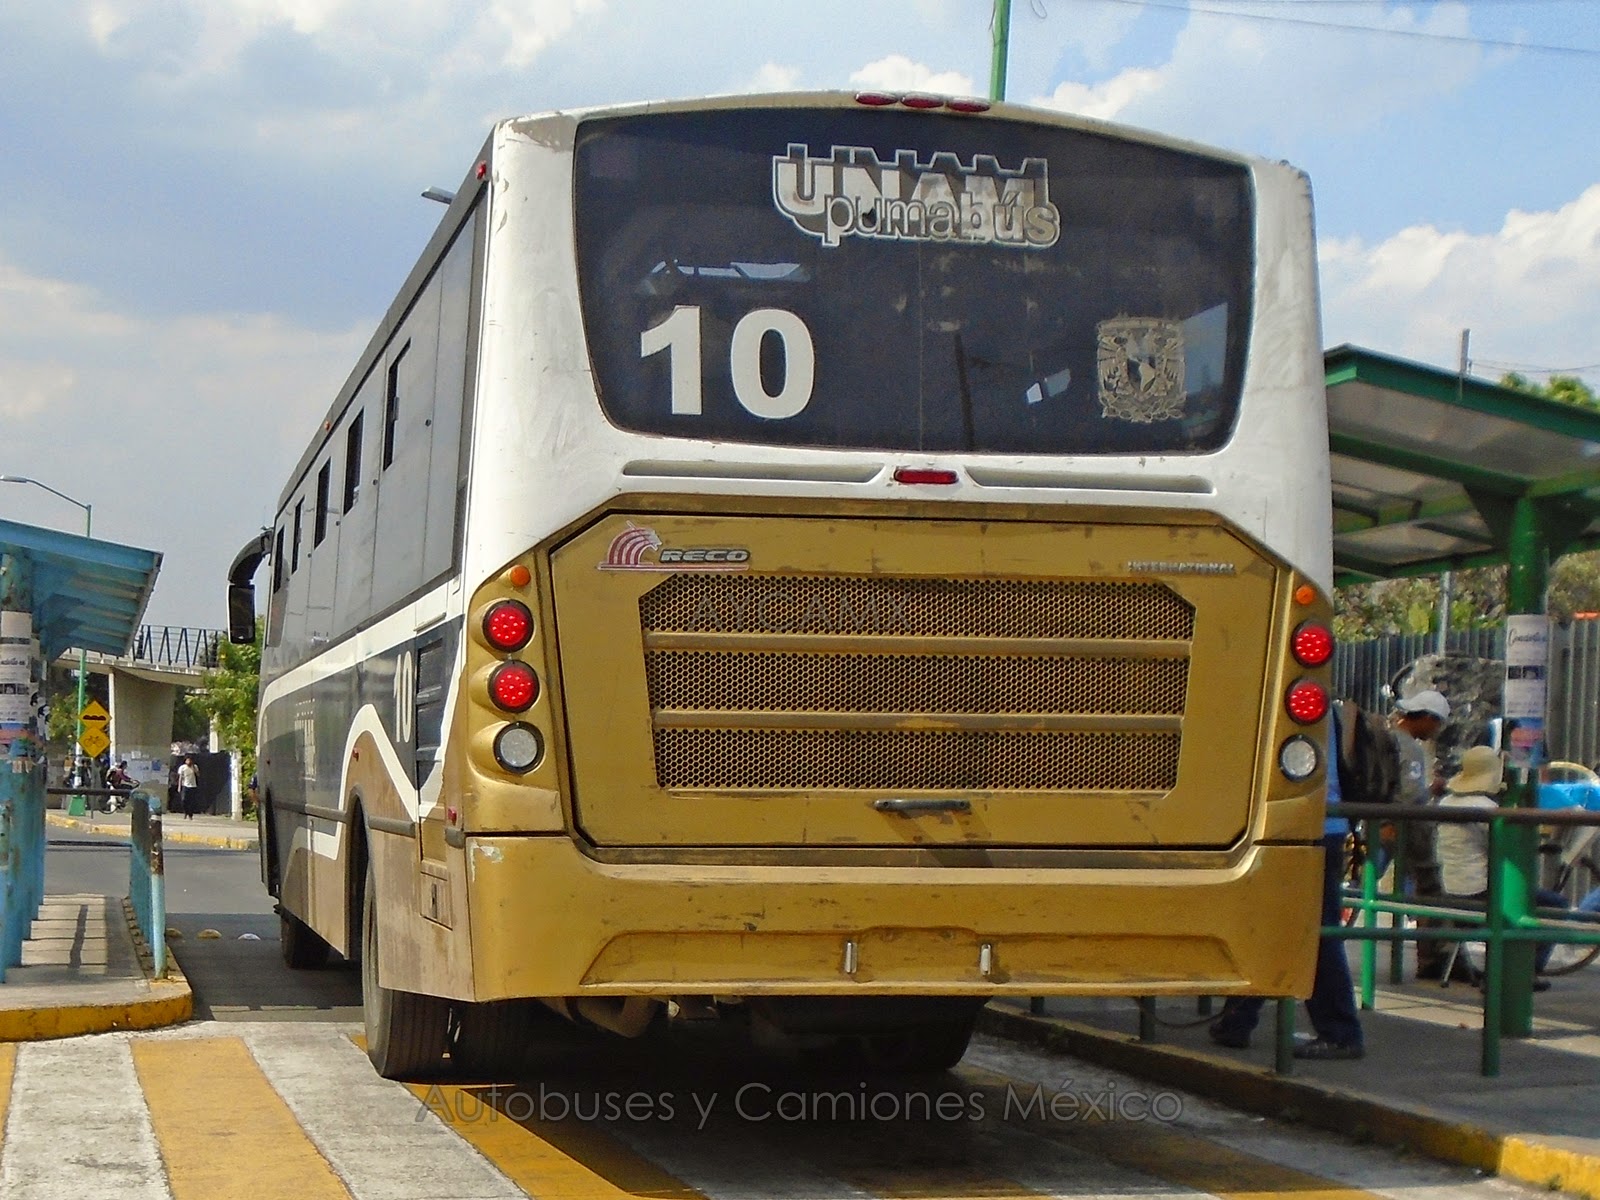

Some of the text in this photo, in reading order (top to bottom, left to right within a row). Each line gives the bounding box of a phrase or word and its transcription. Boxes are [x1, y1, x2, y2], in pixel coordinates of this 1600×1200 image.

[773, 143, 1047, 230] UNAM
[823, 190, 1060, 246] pumabús
[640, 304, 816, 420] 10
[660, 549, 750, 563] RECO
[393, 650, 413, 743] 10
